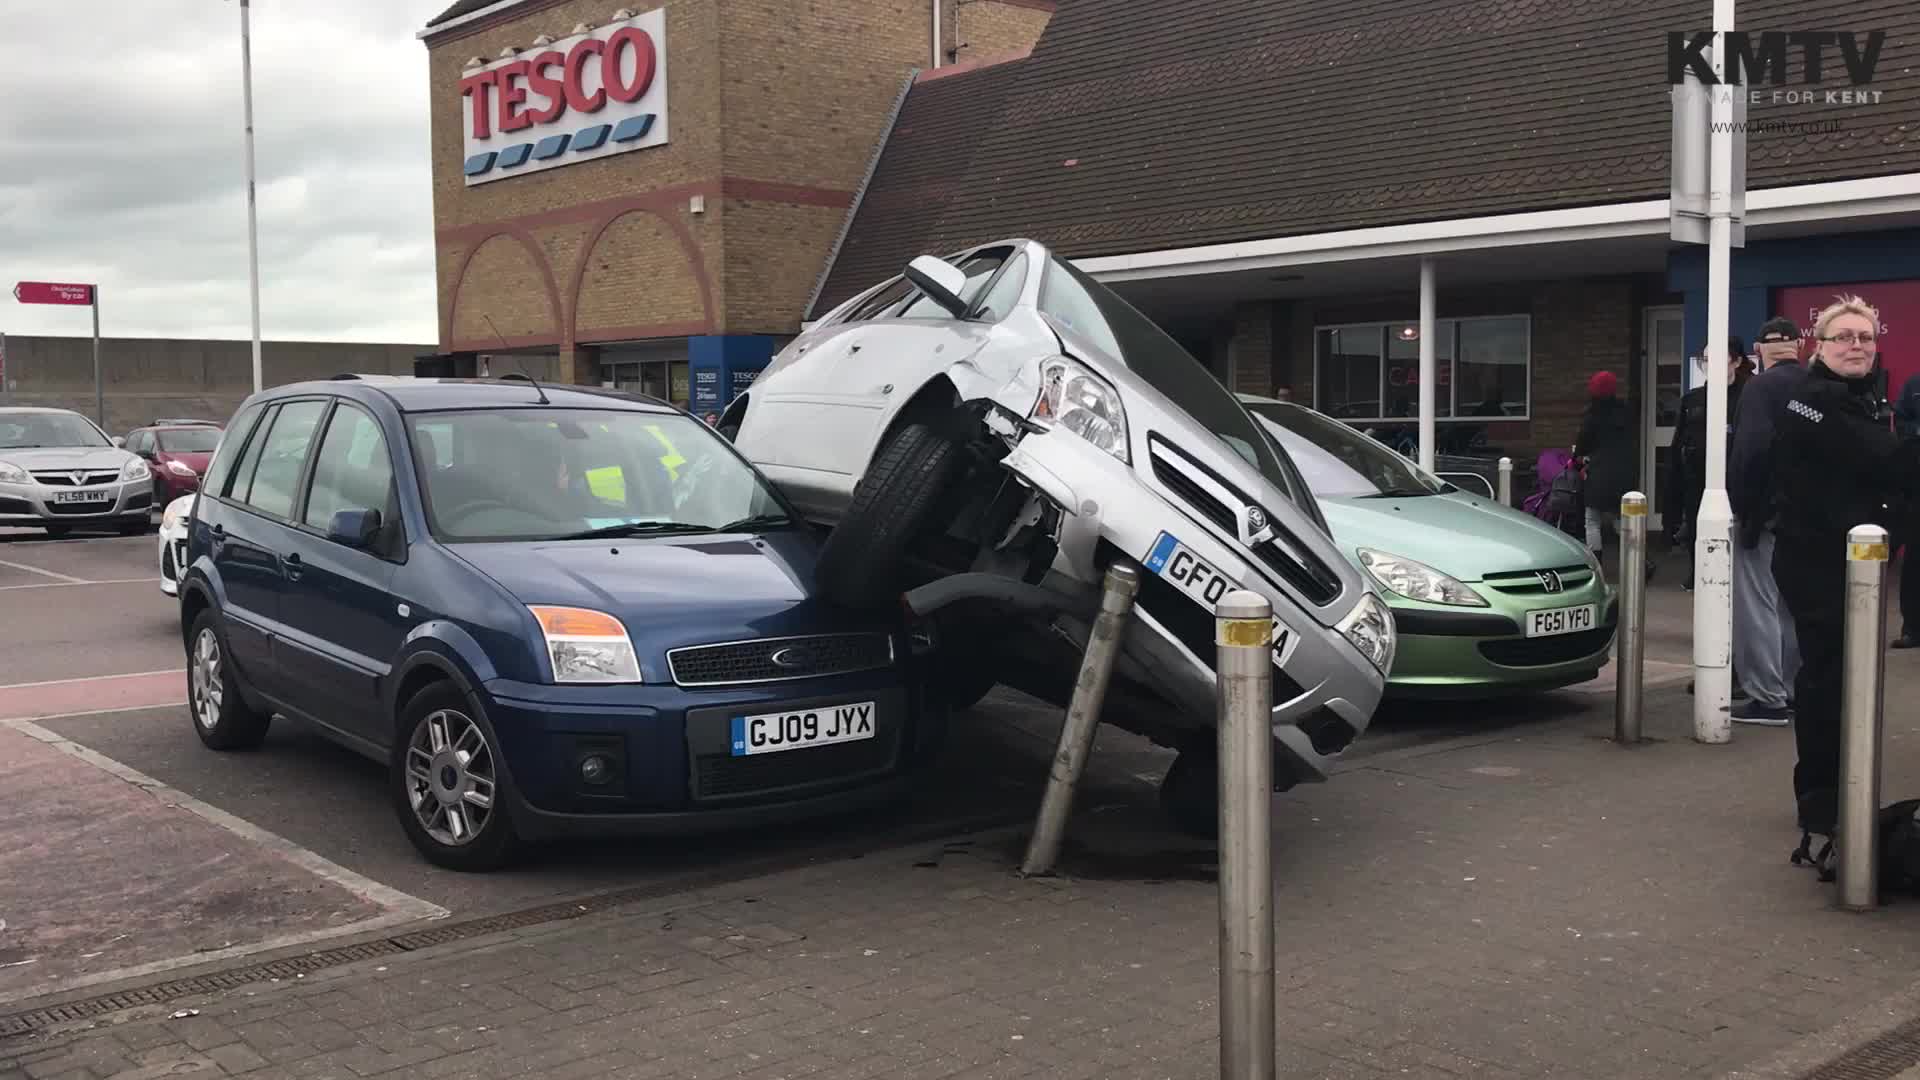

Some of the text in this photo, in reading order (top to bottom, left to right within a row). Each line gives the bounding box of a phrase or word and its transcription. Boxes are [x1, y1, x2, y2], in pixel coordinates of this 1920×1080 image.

[458, 27, 656, 139] TESCO
[61, 291, 71, 300] By
[696, 372, 717, 380] TESCO
[1389, 366, 1451, 386] CAE
[1169, 551, 1238, 605] GF0
[1535, 611, 1565, 633] FG51
[750, 705, 871, 747] GJ09 JYX
